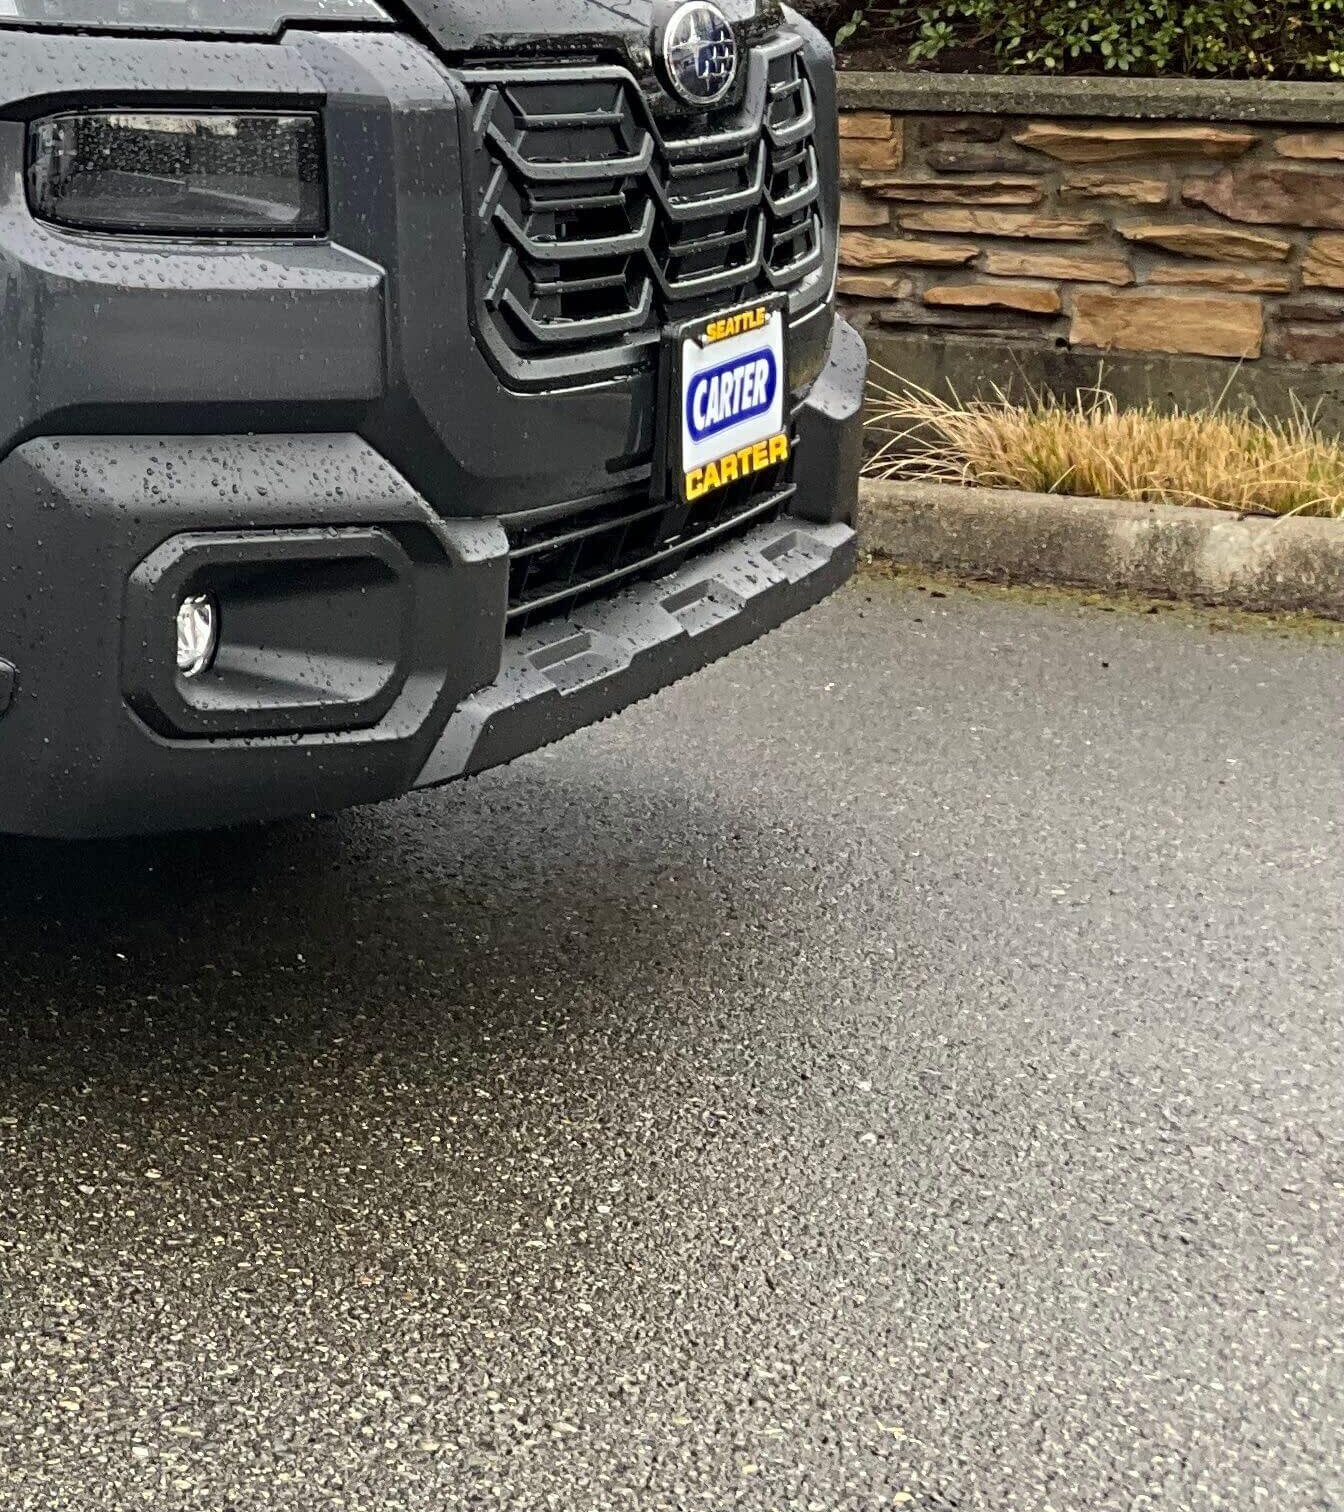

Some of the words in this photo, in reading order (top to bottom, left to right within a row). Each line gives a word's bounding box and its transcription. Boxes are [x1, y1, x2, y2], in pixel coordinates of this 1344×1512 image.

[706, 307, 766, 341] SEATTLE
[692, 358, 769, 431] CARTER
[685, 433, 789, 501] CARTER
